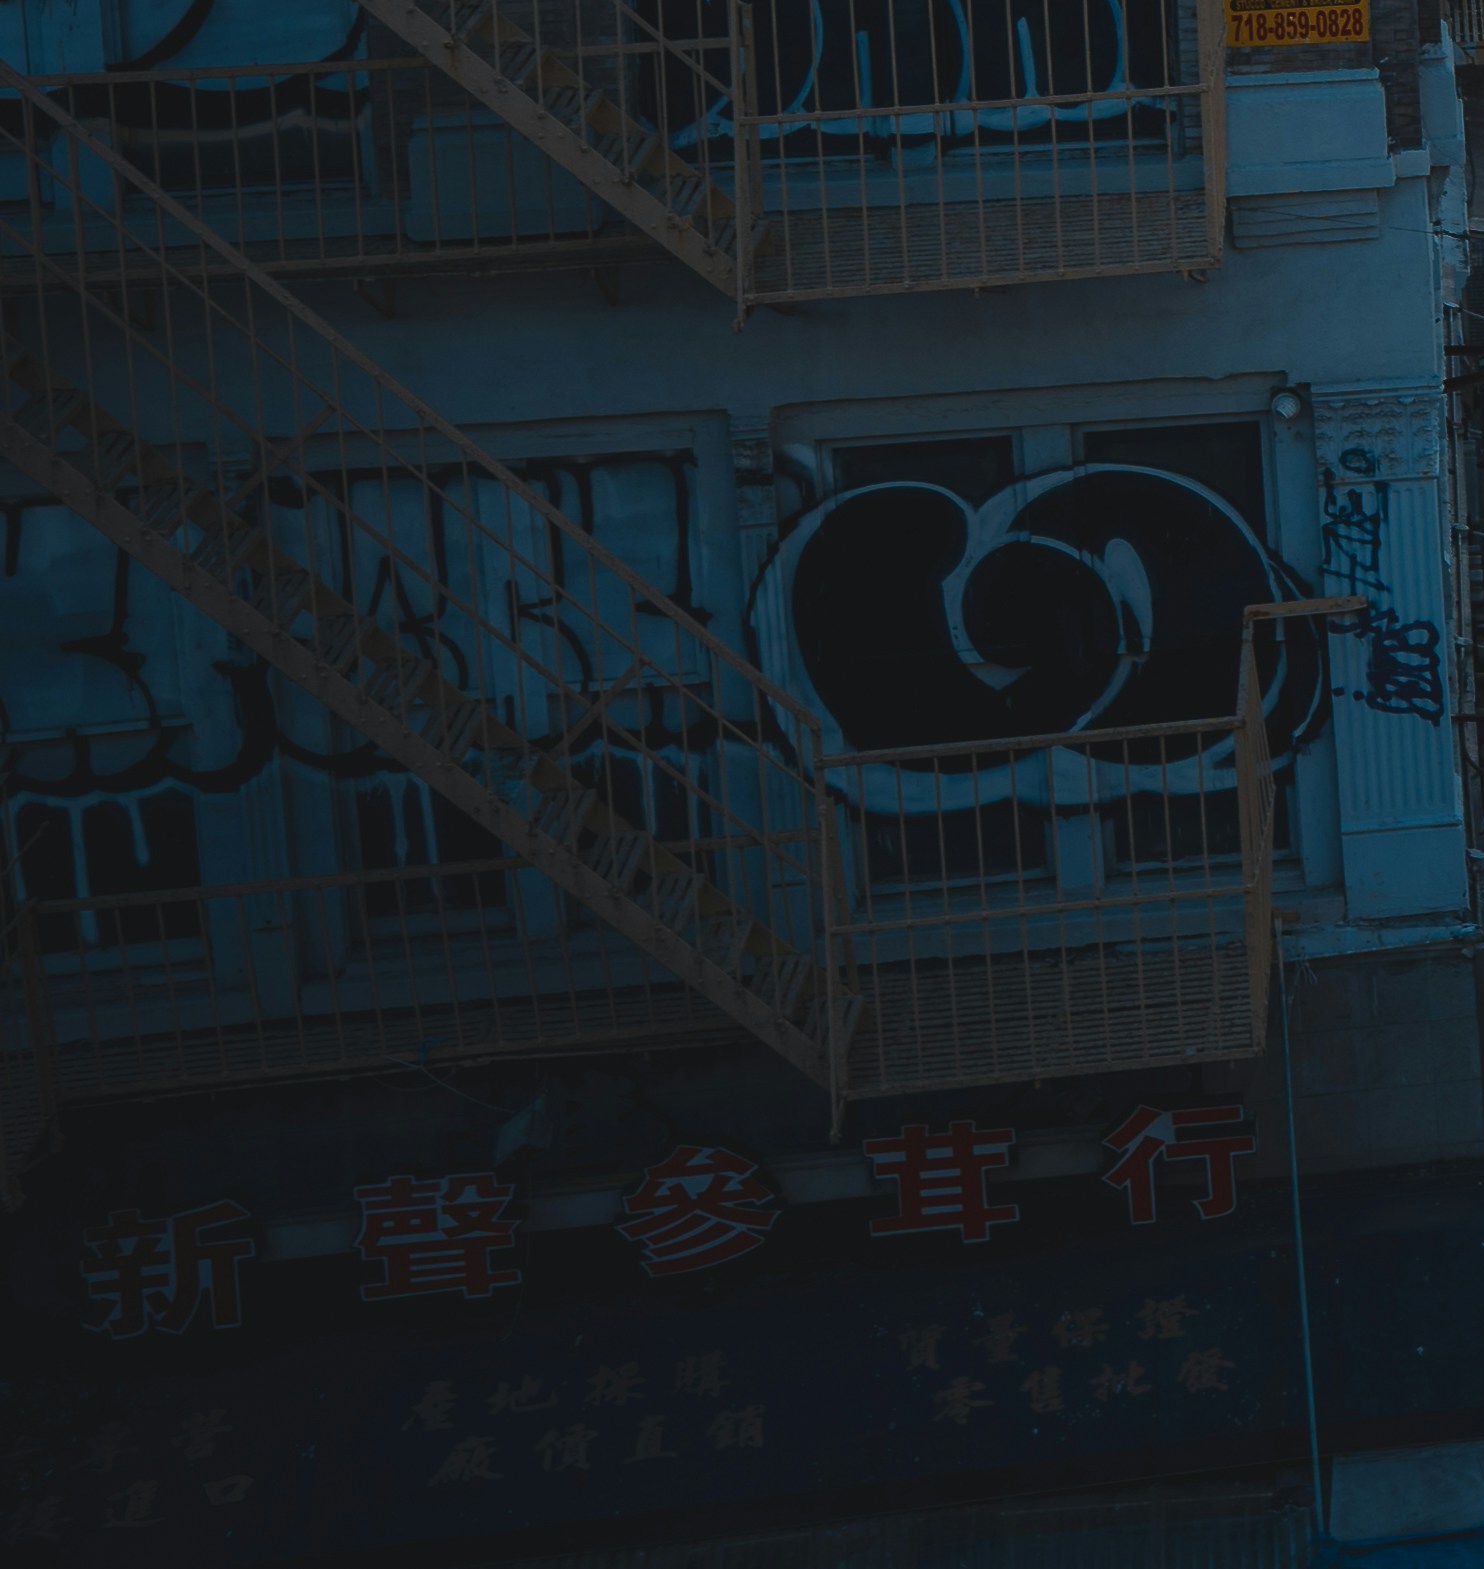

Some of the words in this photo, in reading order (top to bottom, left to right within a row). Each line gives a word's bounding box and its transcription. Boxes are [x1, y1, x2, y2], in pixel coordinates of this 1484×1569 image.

[1231, 7, 1364, 42] 718-859-0828
[80, 1103, 1257, 1340] 新聲參茸行
